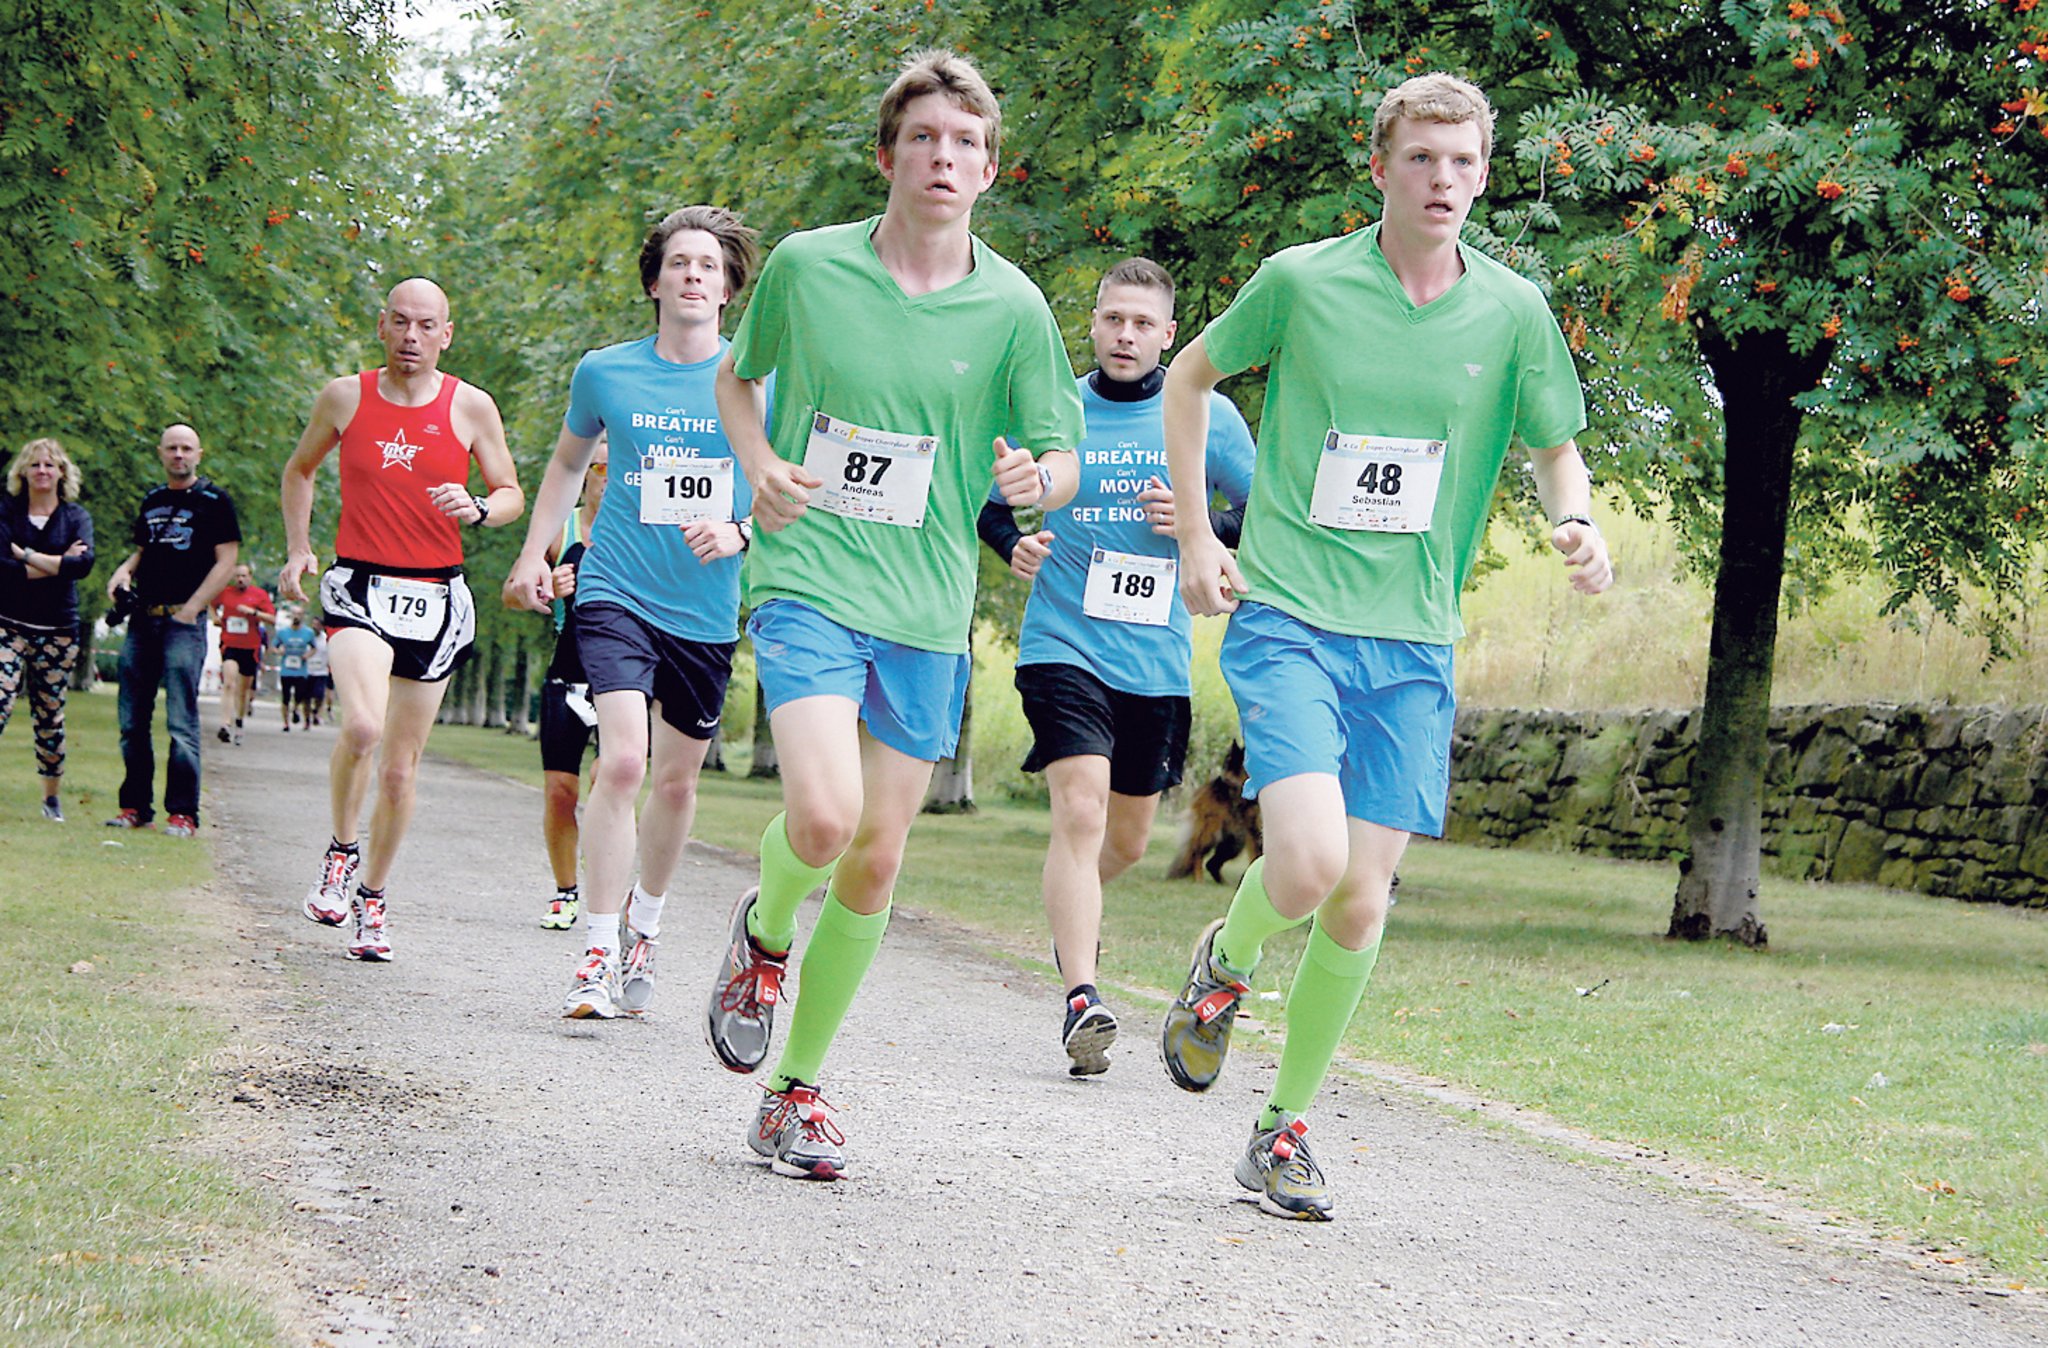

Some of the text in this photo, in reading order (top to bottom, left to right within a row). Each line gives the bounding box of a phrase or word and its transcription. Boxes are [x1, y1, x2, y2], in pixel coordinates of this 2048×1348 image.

[631, 413, 717, 434] BREATHE
[647, 444, 701, 458] MOVE
[1084, 450, 1168, 466] BREATHE
[844, 452, 892, 485] 87
[623, 472, 641, 487] GE
[1099, 478, 1152, 494] MOVE
[1357, 462, 1402, 495] 48
[664, 475, 712, 499] 190
[841, 483, 884, 498] Andreas
[1352, 495, 1401, 507] Sebastian
[1072, 507, 1146, 522] GET ENO
[1111, 571, 1155, 598] 189
[388, 594, 427, 618] 179
[763, 985, 777, 1002] 87
